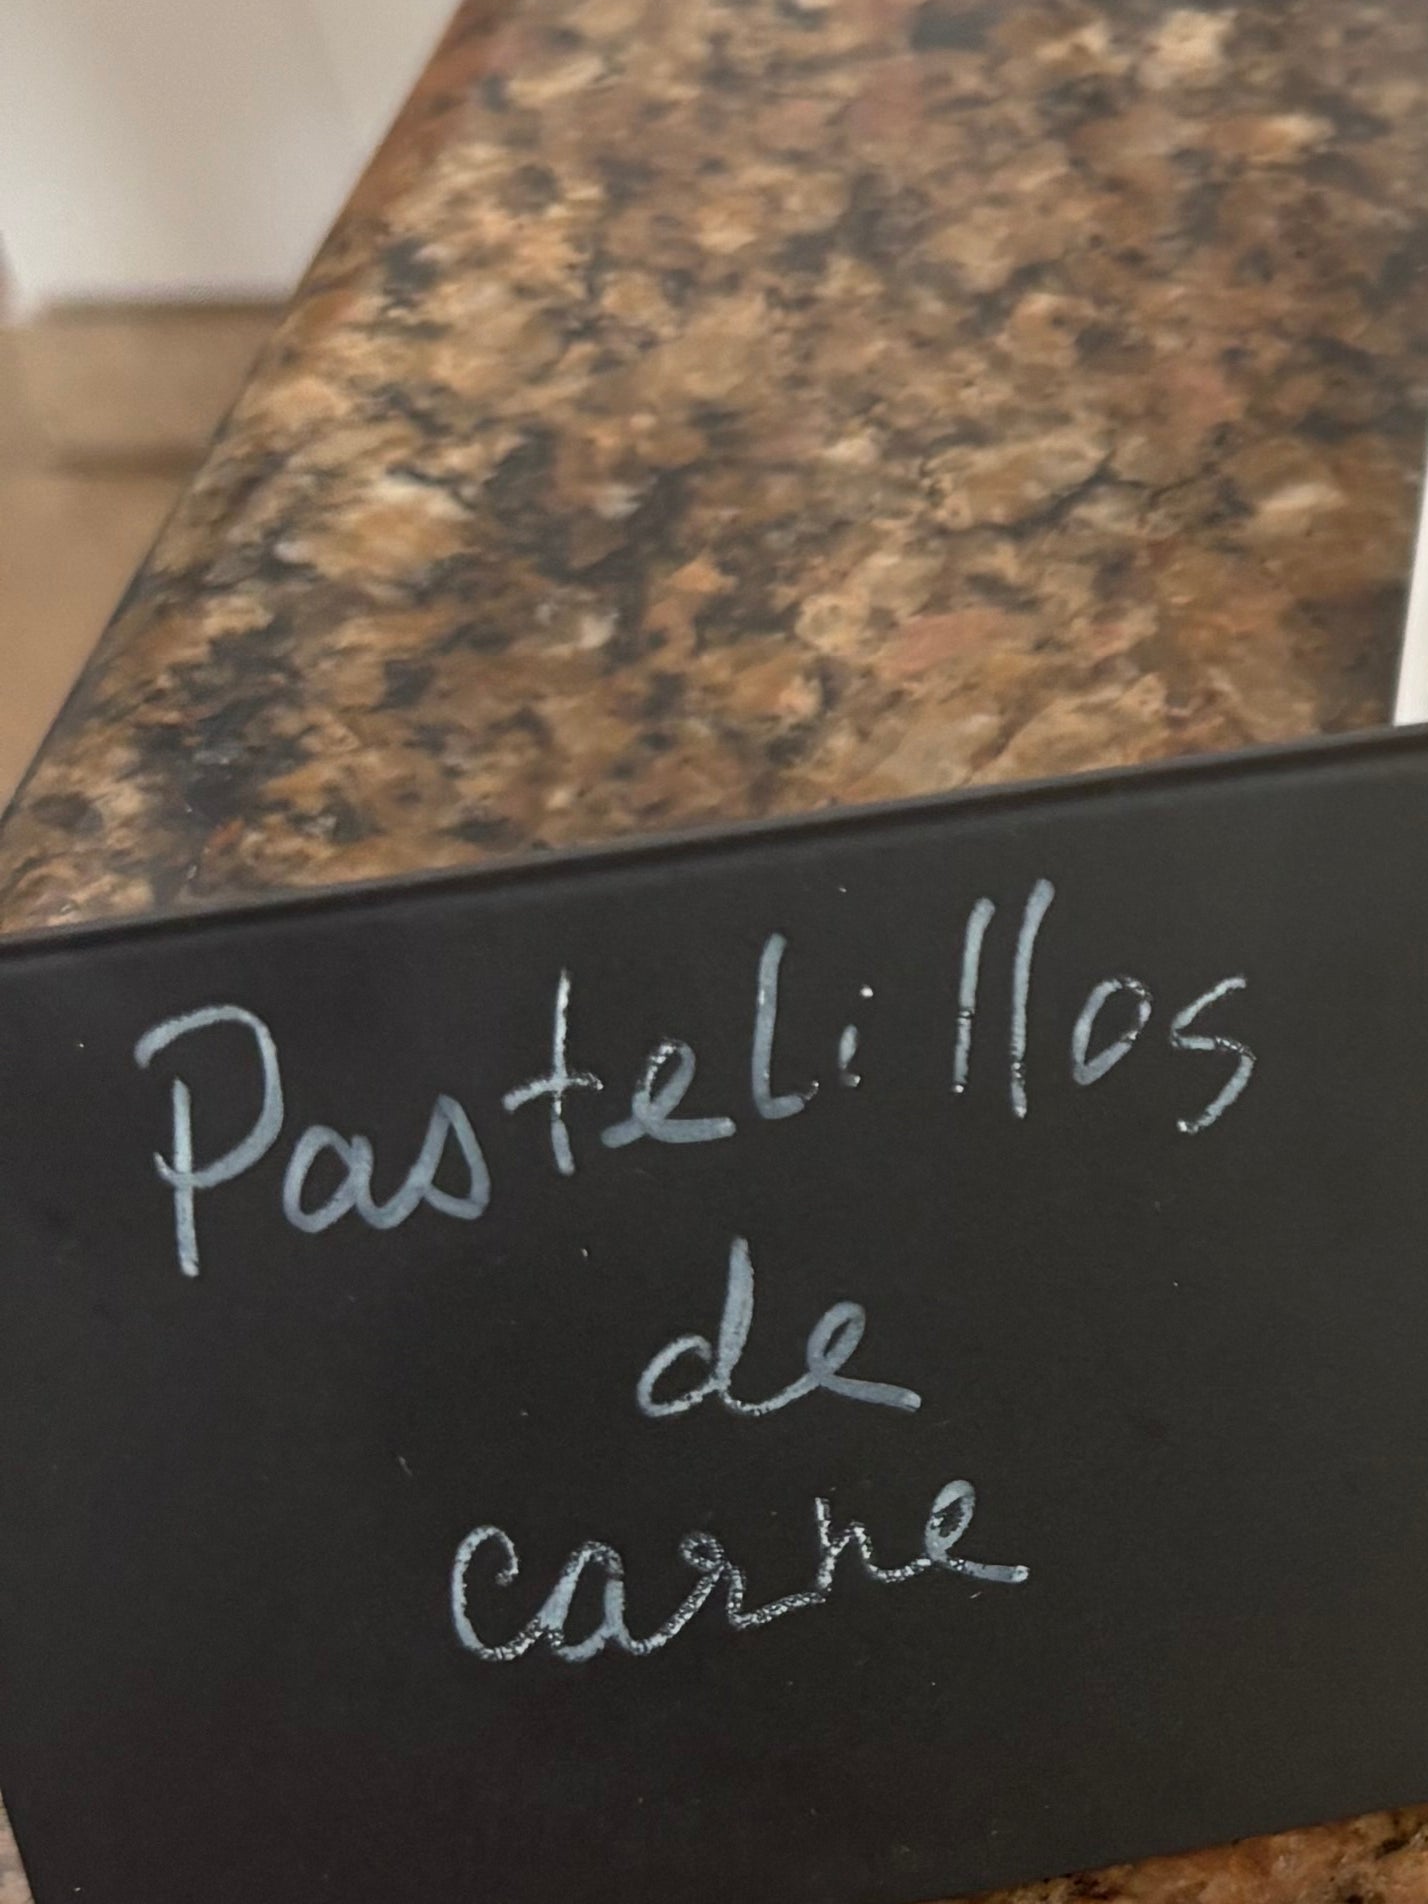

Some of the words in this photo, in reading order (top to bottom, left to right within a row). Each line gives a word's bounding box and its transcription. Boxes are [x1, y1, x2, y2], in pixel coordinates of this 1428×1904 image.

[133, 877, 1256, 1277] Pastelillos
[637, 1238, 923, 1417] de
[451, 1479, 1029, 1662] carne
